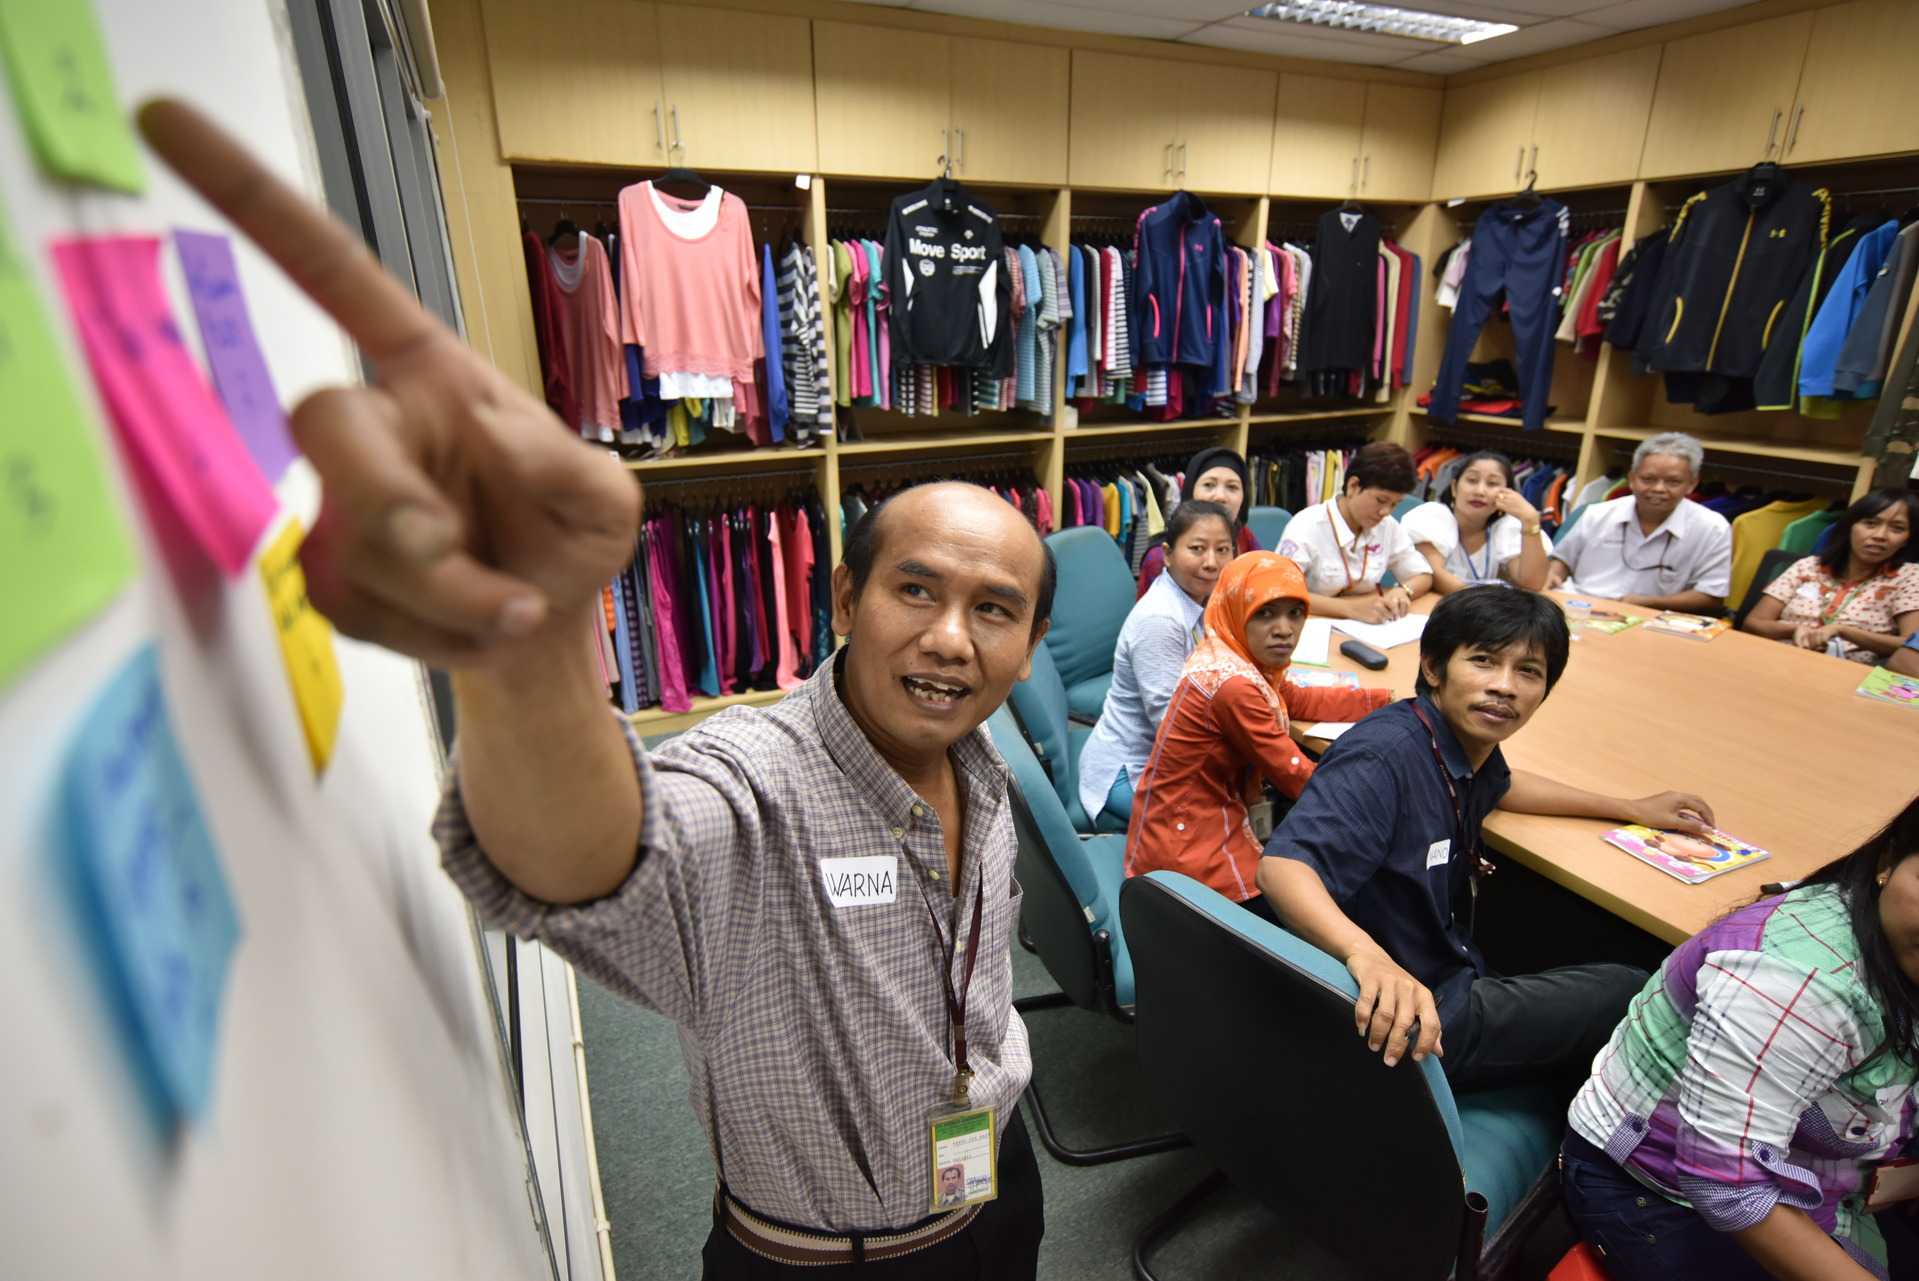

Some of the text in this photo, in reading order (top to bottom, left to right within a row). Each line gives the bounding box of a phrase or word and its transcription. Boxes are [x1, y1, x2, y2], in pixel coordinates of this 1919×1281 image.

[909, 238, 986, 263] Move Sport
[825, 870, 893, 897] WARNA
